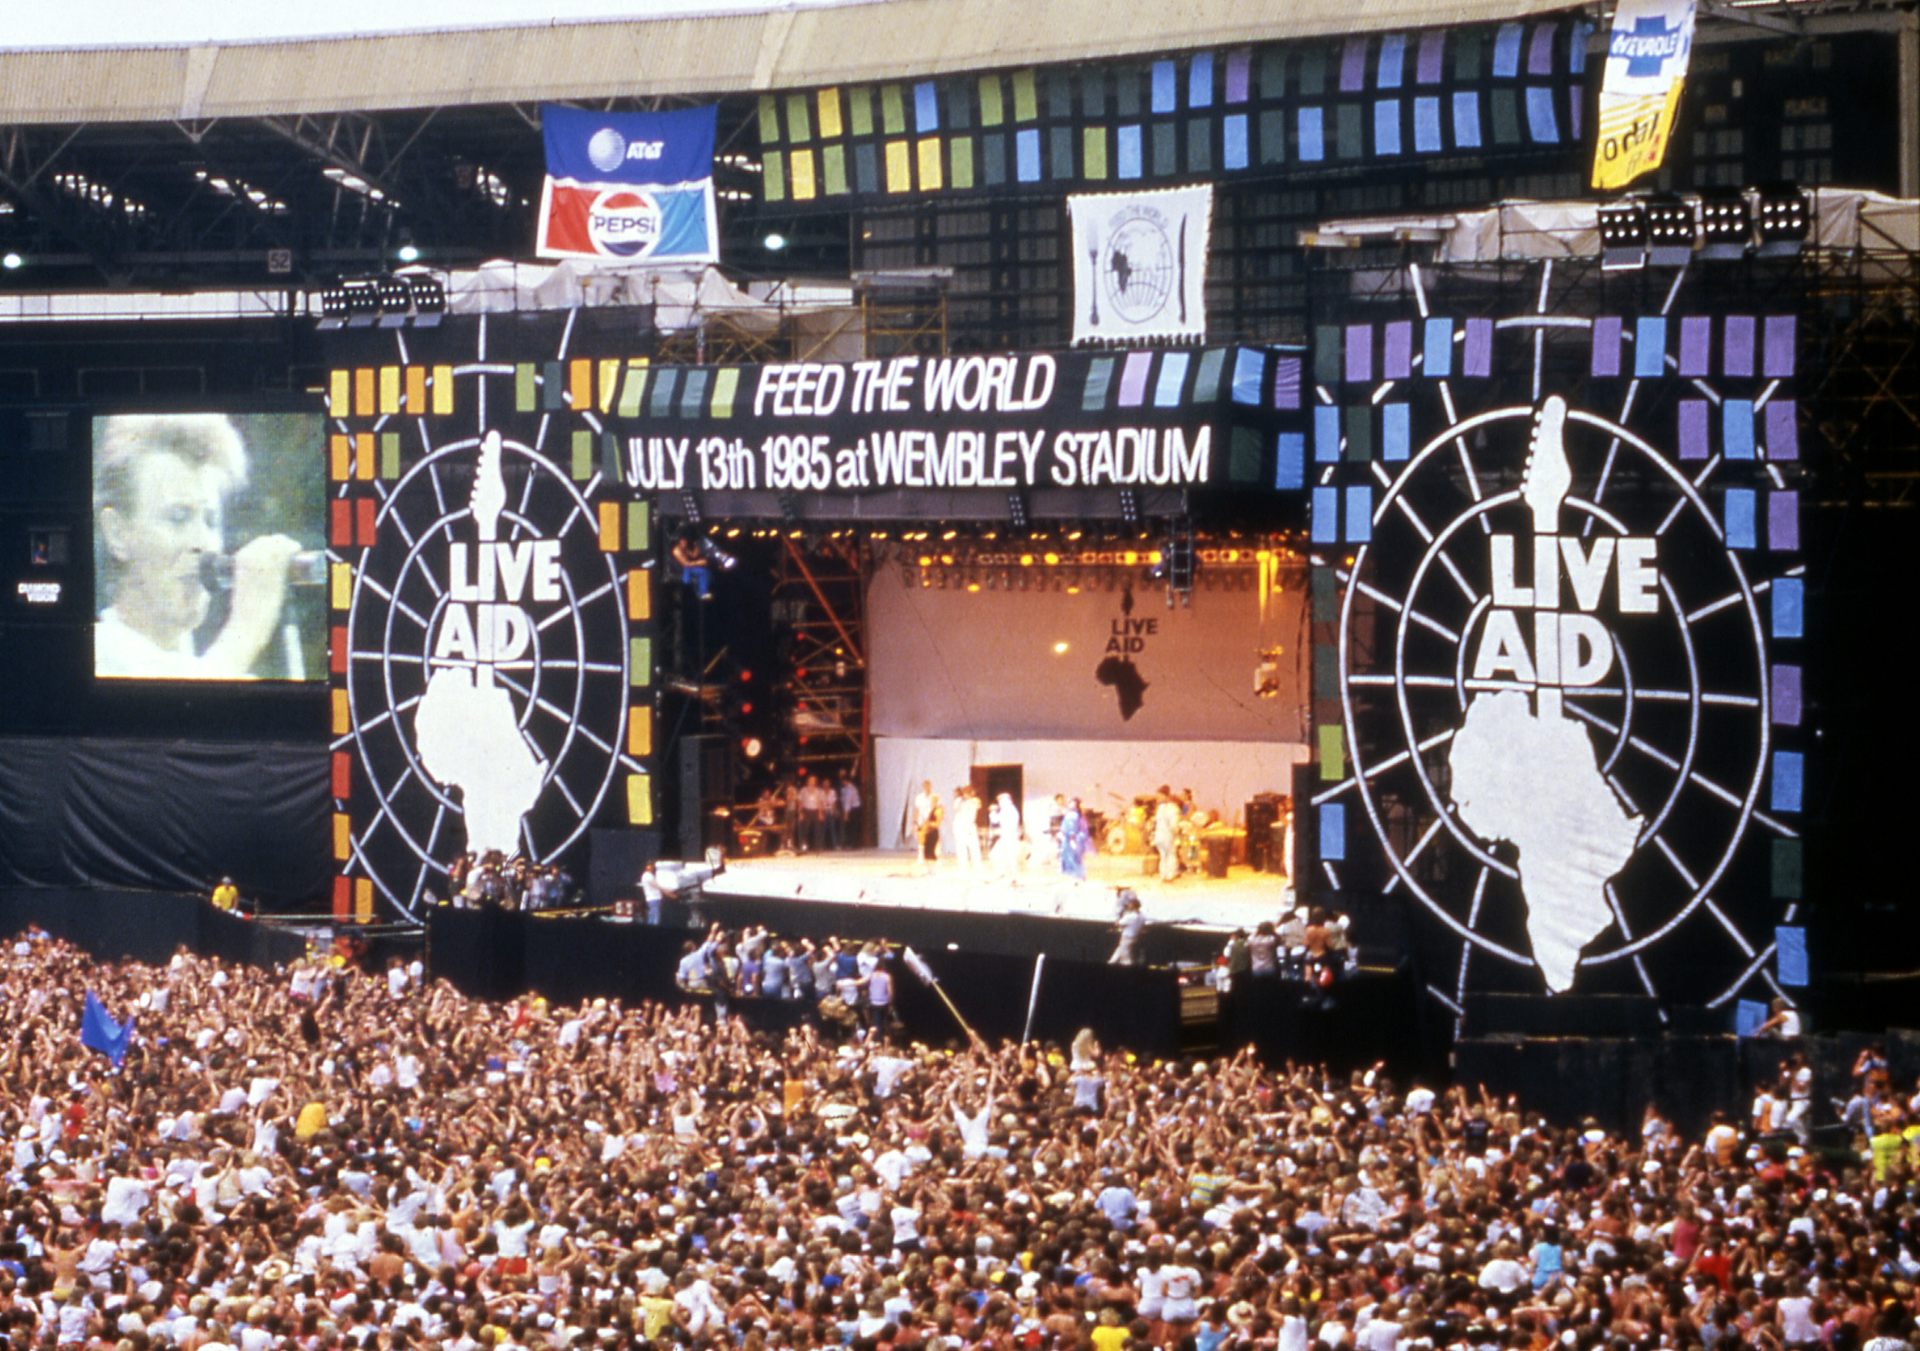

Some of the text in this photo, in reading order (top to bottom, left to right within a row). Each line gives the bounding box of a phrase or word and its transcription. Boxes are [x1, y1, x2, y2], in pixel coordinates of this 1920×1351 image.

[625, 140, 665, 160] AT&T
[593, 215, 657, 234] PEPSI
[754, 354, 1057, 417] FEED THE WORLD
[626, 425, 1212, 490] JULY 13th 1985 at WEMBLEY STADIUM
[449, 540, 562, 602] LIVE
[1489, 534, 1659, 613] LIVE
[434, 602, 531, 662] AID
[1105, 636, 1145, 653] AID
[1111, 618, 1158, 635] LIVE
[1472, 609, 1614, 687] AID
